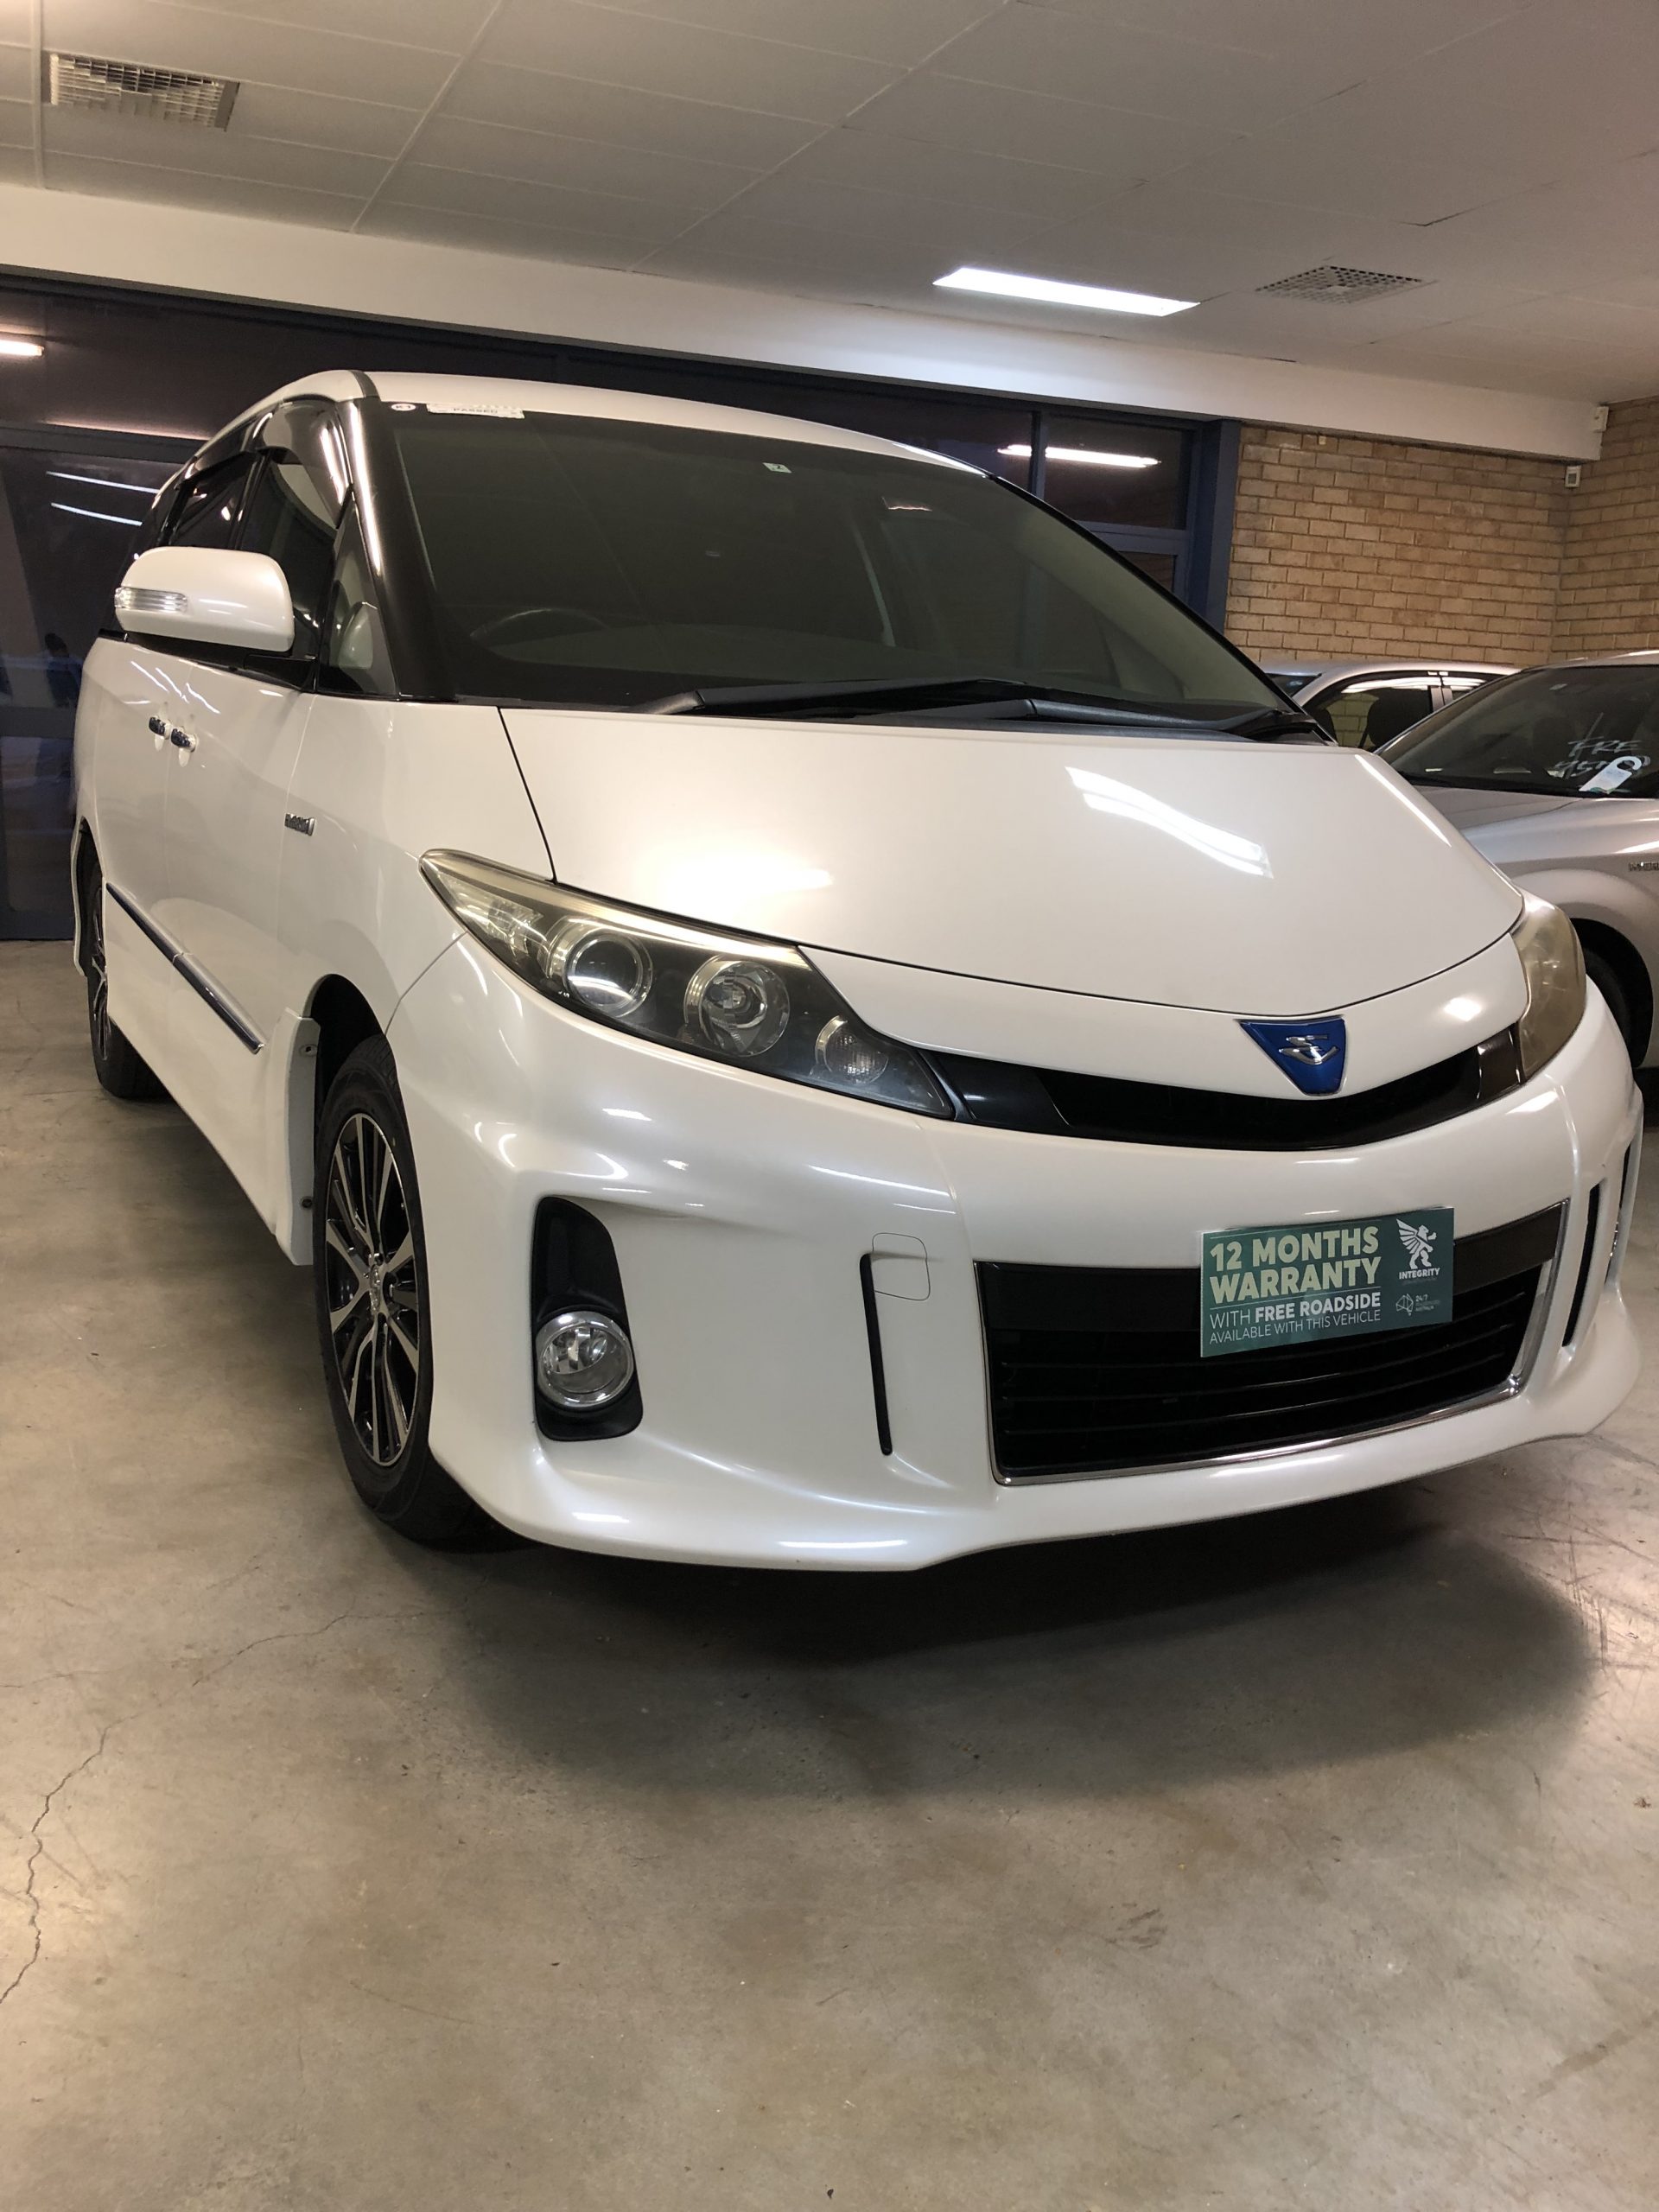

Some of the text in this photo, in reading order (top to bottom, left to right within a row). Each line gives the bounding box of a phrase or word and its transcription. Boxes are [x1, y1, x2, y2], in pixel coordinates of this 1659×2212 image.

[1210, 1225, 1380, 1272] 12 MONTHS
[1209, 1256, 1382, 1305] WARRANTY
[1398, 1267, 1441, 1280] INTEGRITY
[1210, 1291, 1382, 1330] WITH FREE ROADSIDE
[1210, 1309, 1382, 1344] AVAILABLE WITH THIS VEHICLE
